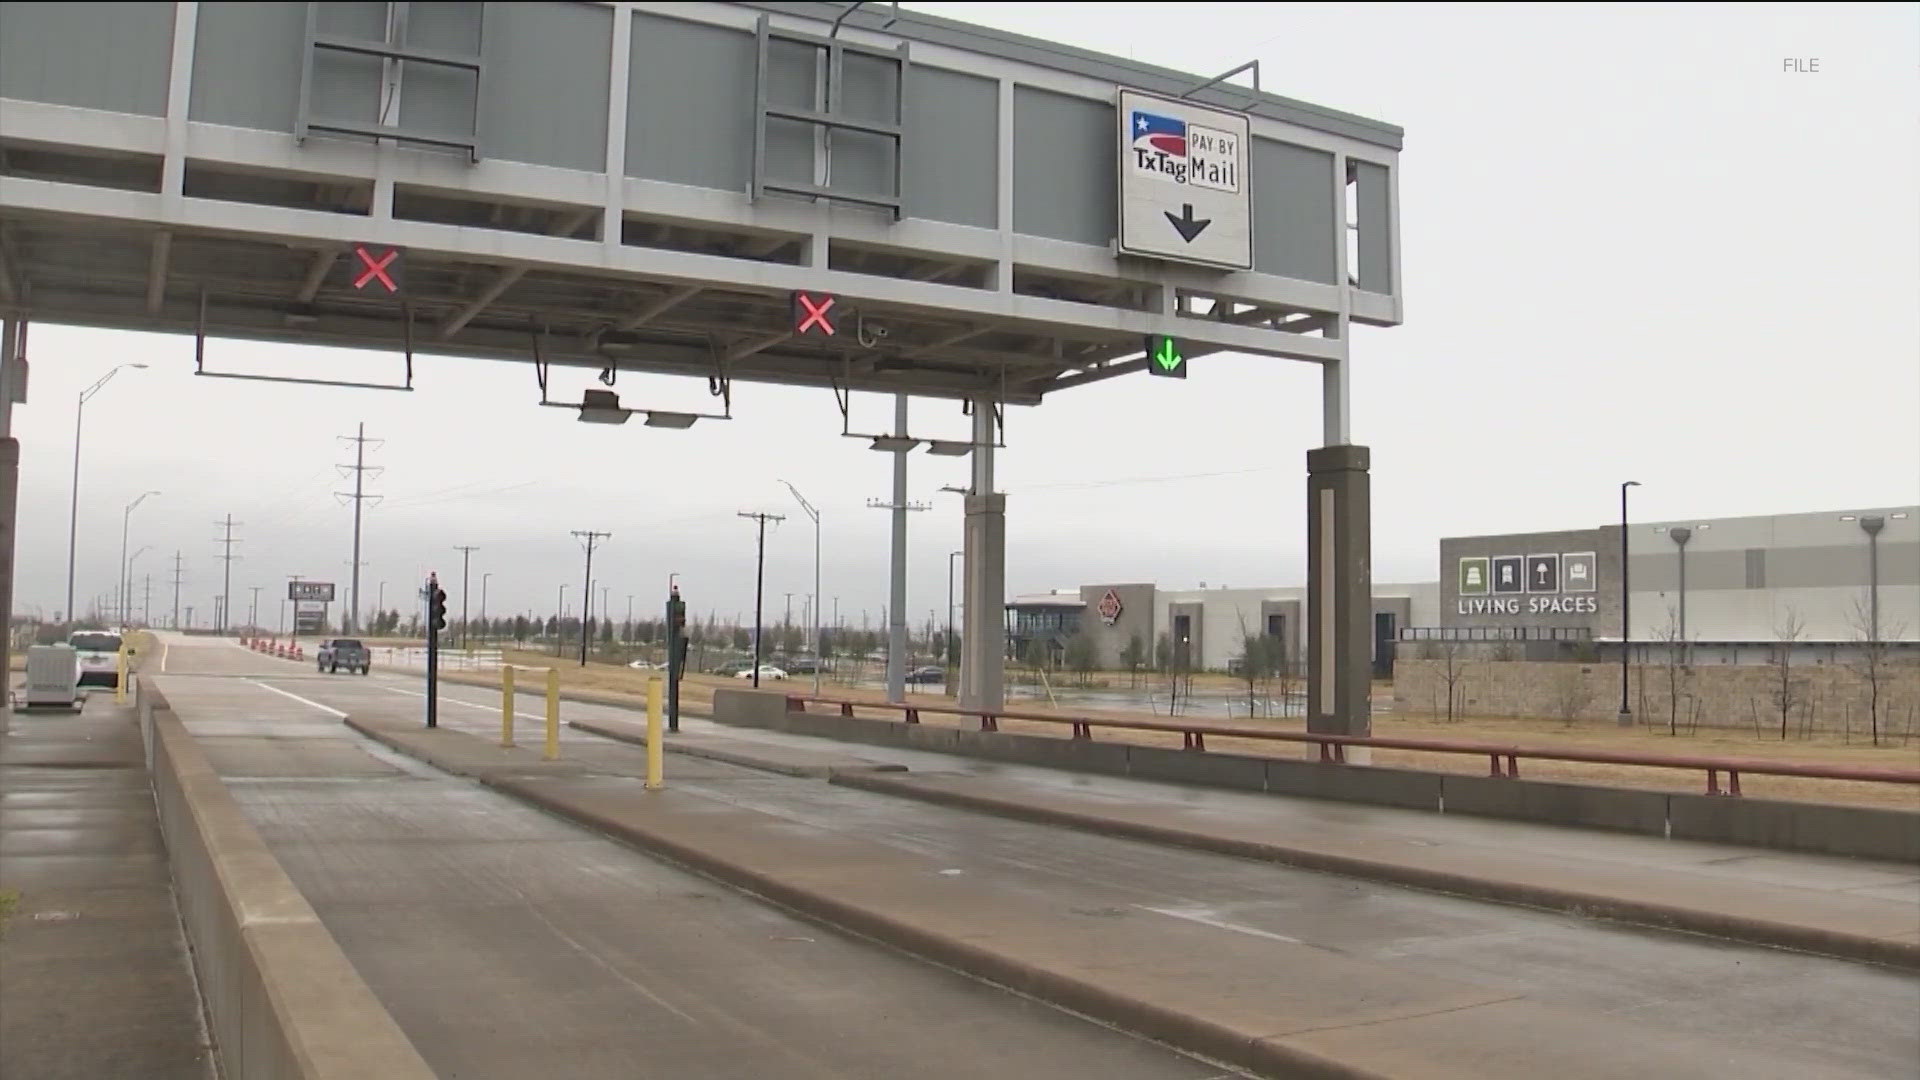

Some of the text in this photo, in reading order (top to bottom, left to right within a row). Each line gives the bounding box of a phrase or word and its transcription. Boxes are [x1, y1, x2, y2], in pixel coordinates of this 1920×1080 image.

[1192, 133, 1234, 156] PAY BY
[1133, 147, 1187, 184] TxTag
[1192, 157, 1236, 186] Mail
[1458, 597, 1598, 615] LIVING SPACES
